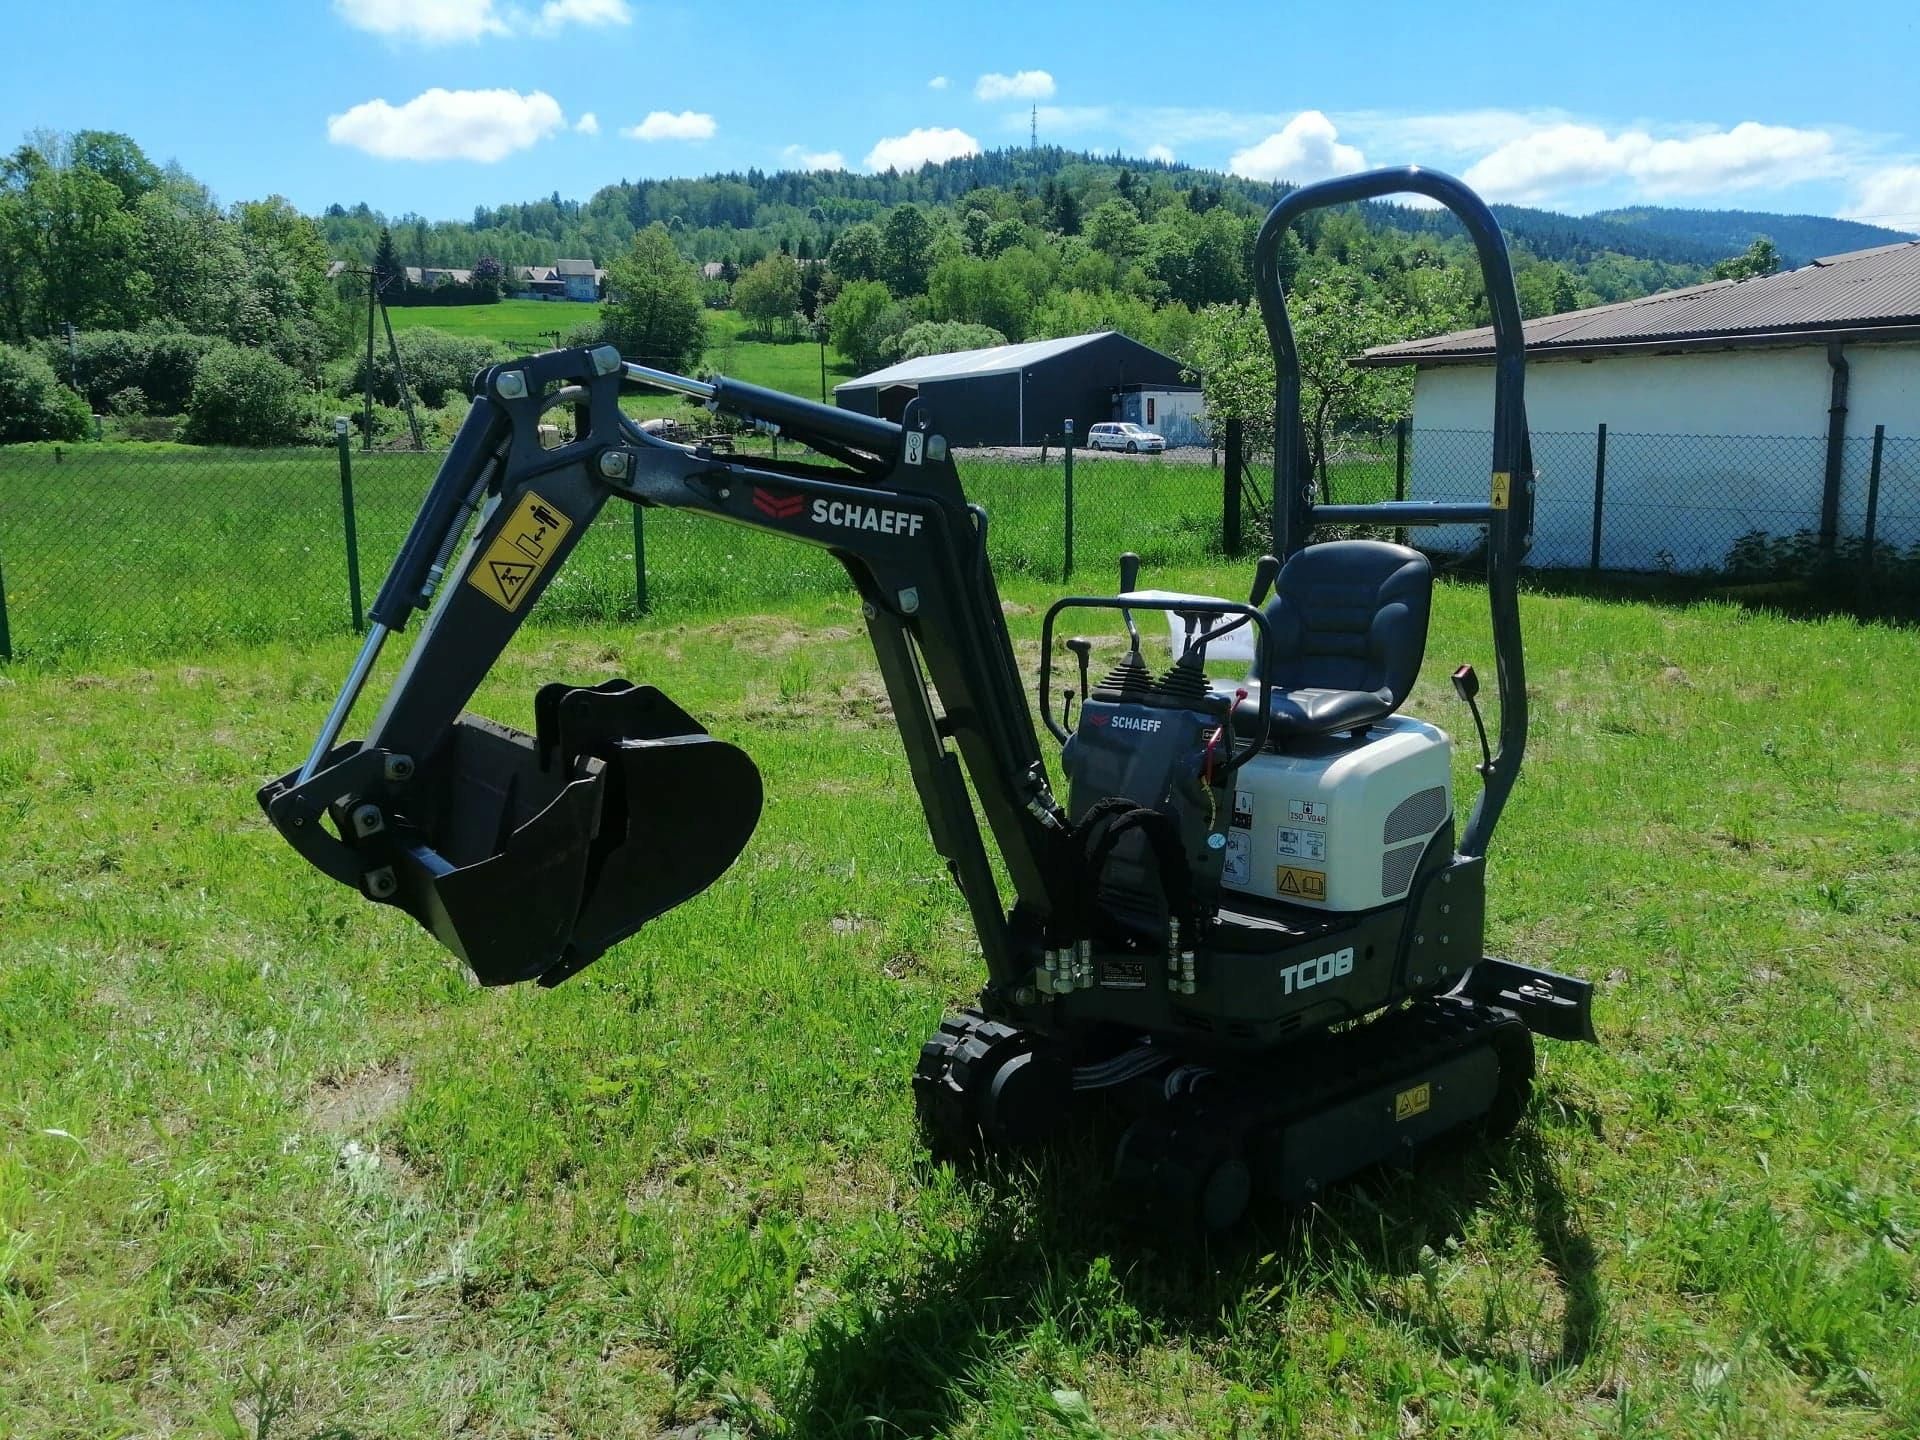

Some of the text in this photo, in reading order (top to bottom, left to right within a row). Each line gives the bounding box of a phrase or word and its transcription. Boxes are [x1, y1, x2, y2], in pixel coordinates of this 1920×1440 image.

[811, 499, 923, 537] SCHAEFF
[1111, 716, 1162, 733] SCHAEFF
[1290, 812, 1304, 821] ISO
[1280, 946, 1354, 995] TC08
